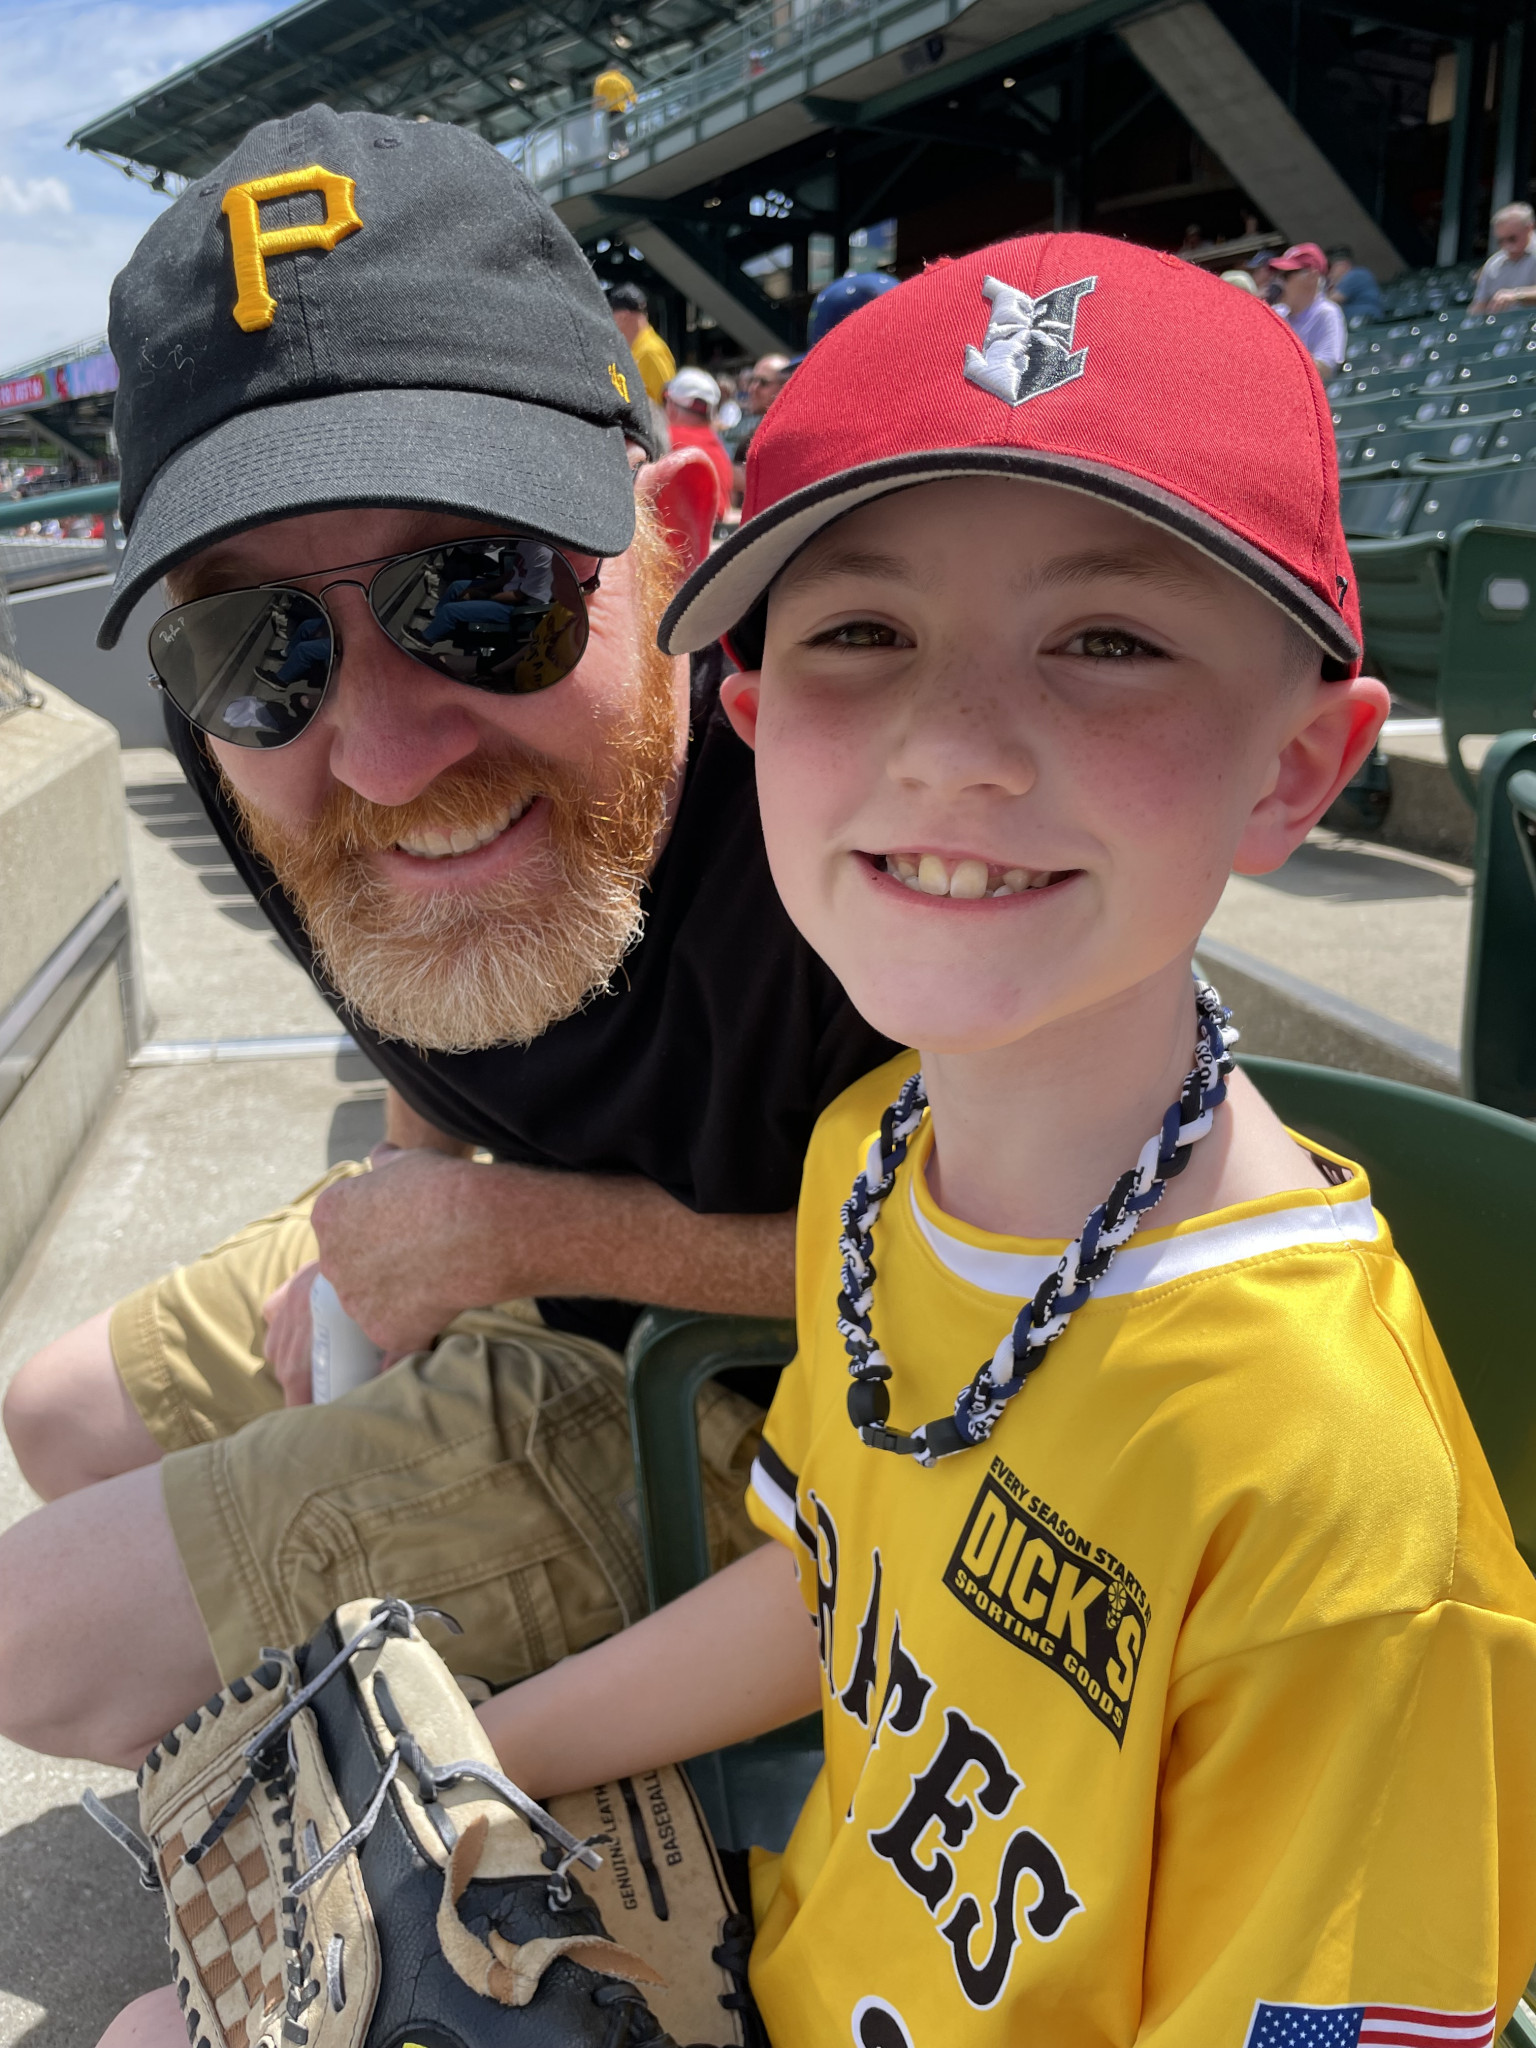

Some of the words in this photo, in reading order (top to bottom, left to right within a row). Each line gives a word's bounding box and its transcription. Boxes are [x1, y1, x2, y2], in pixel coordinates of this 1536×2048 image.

[222, 165, 363, 332] P
[960, 1489, 1142, 1703] DICK'S
[989, 1455, 1030, 1502] EVERY
[1027, 1496, 1092, 1557] SEASON
[1093, 1547, 1147, 1609] STARTS
[954, 1569, 1056, 1656] SPORTING
[1062, 1653, 1124, 1729] GOODS
[595, 1783, 617, 1833] LEATH
